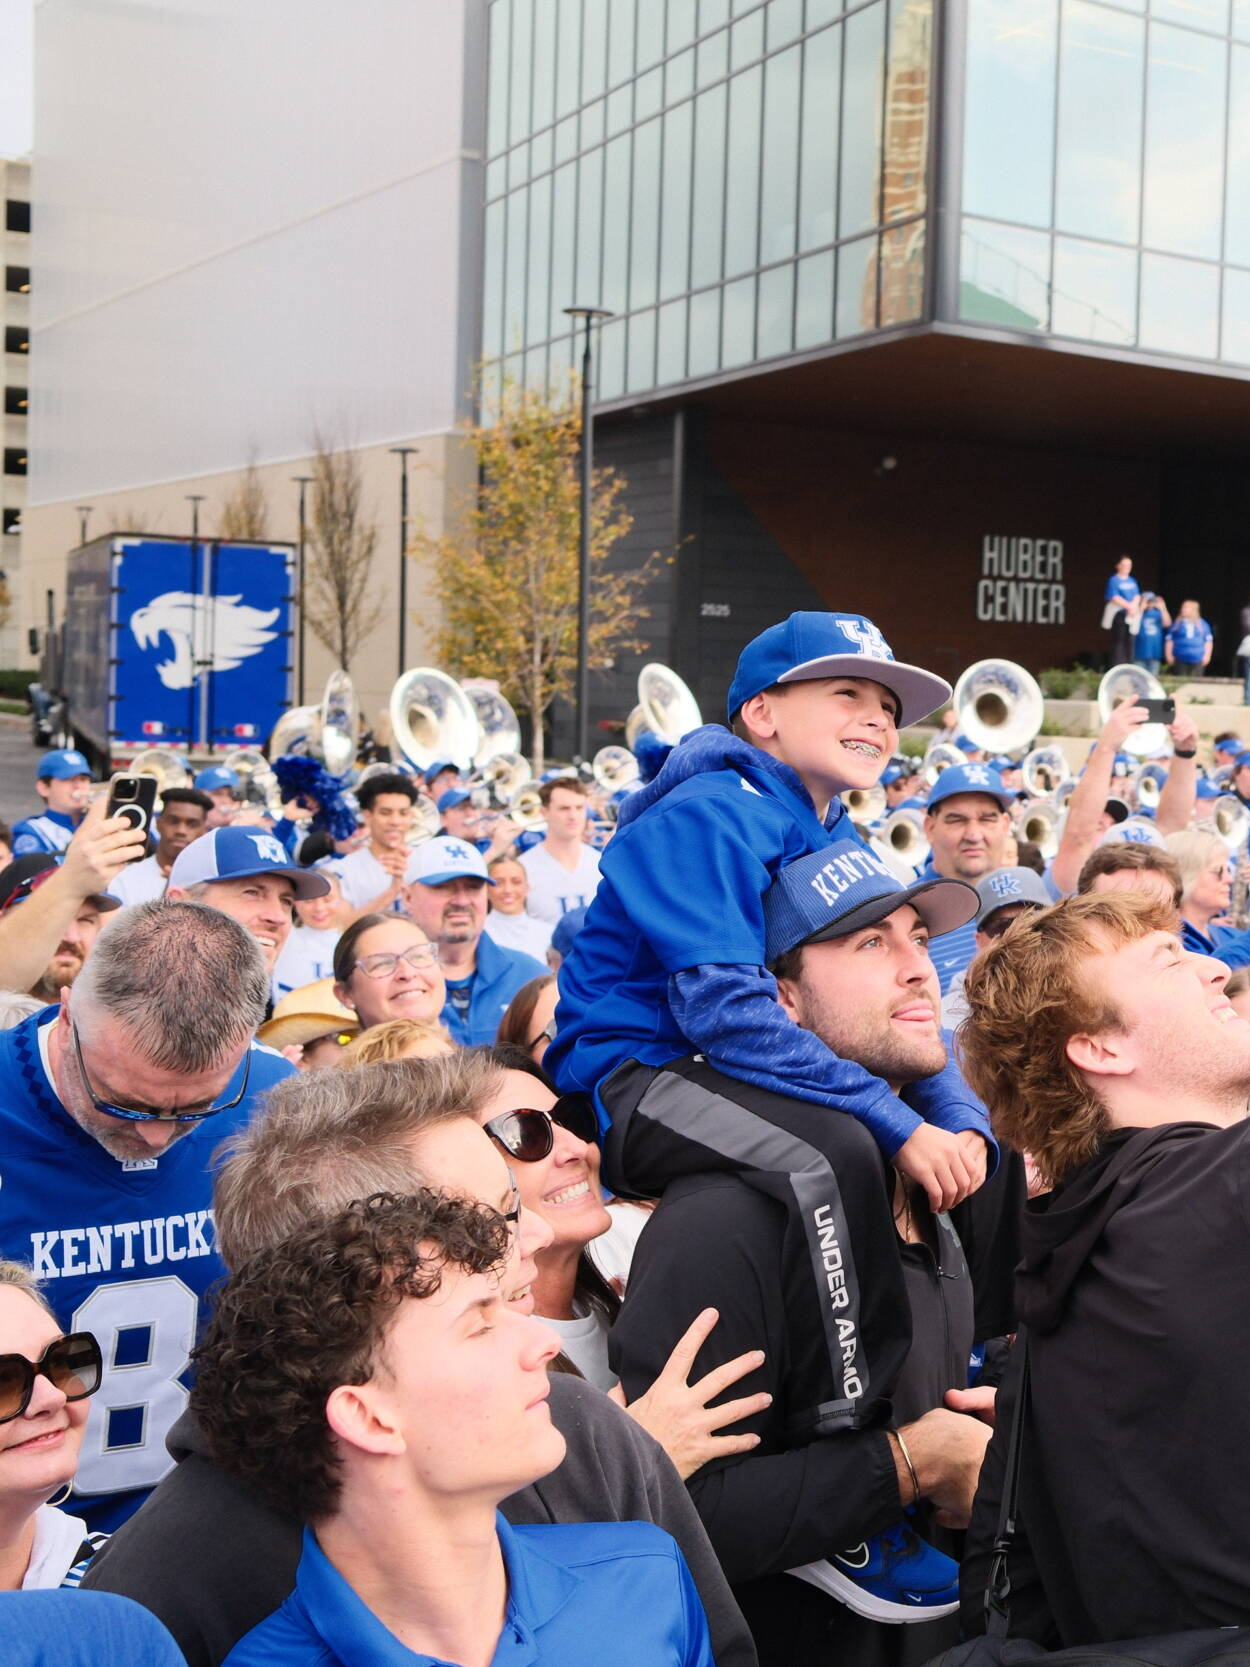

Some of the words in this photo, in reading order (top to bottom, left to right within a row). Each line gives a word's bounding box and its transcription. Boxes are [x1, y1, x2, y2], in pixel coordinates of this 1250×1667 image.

[983, 535, 1064, 580] HUBER
[701, 603, 730, 617] 2525
[977, 579, 1066, 625] CENTER
[814, 1204, 850, 1310] UNDER
